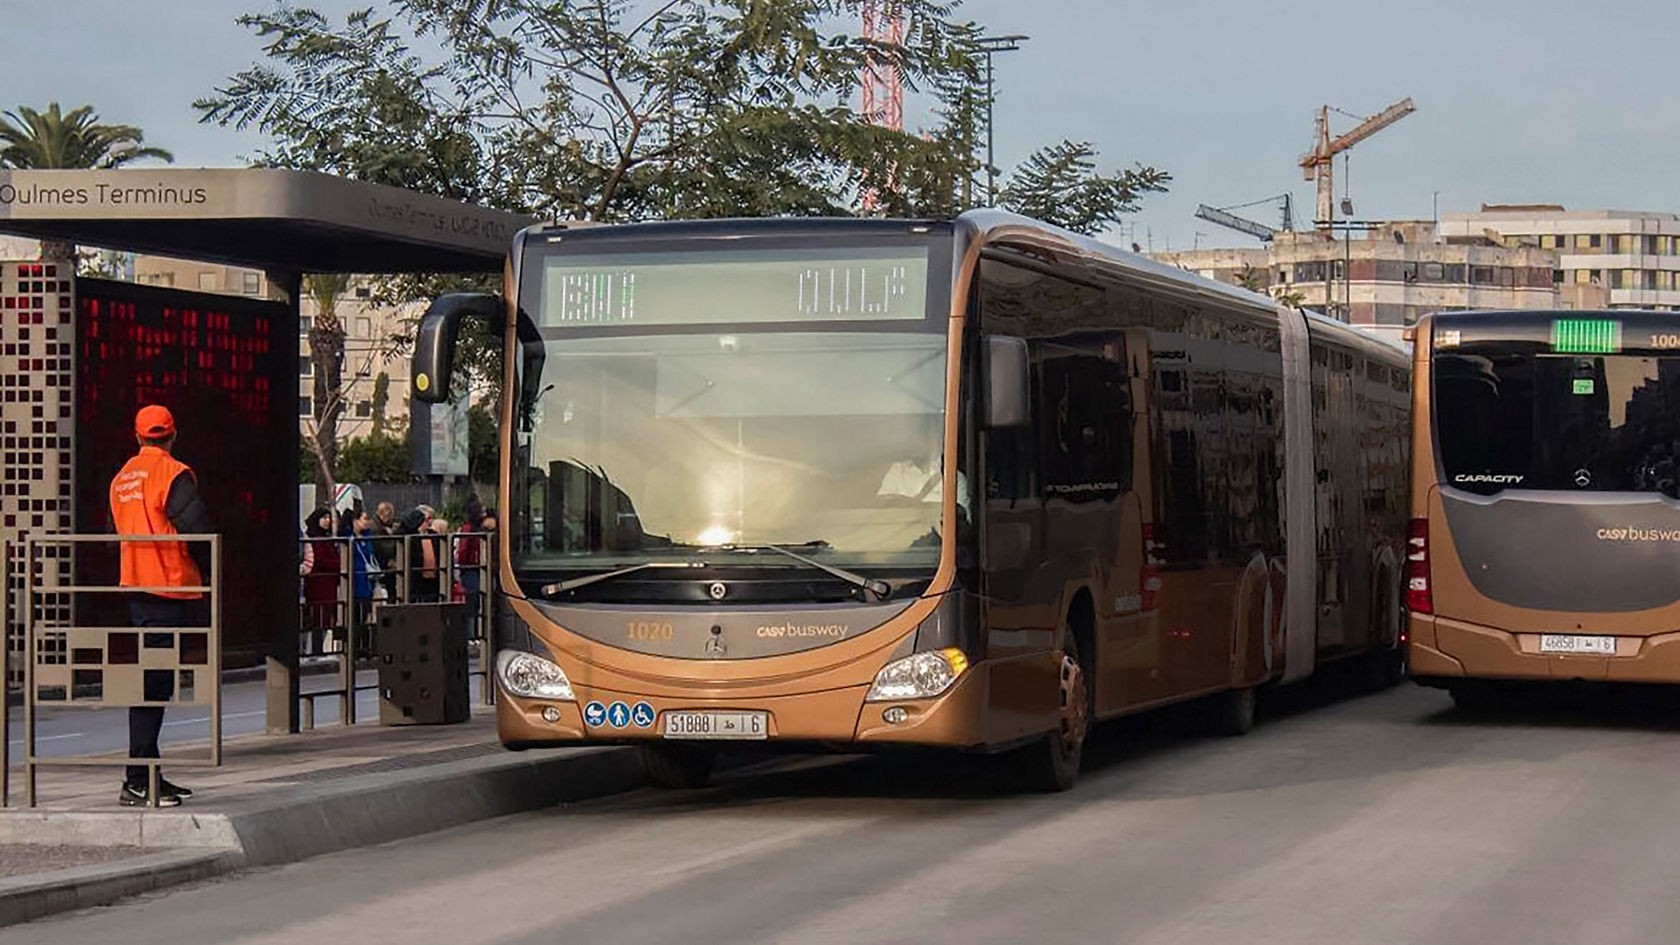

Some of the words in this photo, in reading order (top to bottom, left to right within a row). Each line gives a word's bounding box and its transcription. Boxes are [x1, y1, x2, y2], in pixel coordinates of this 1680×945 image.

[0, 184, 88, 204] Oulmes
[96, 182, 207, 204] Terminus
[1650, 335, 1680, 348] 100
[1455, 474, 1524, 483] CAPACITY
[626, 622, 673, 641] 1020
[751, 715, 760, 732] 6
